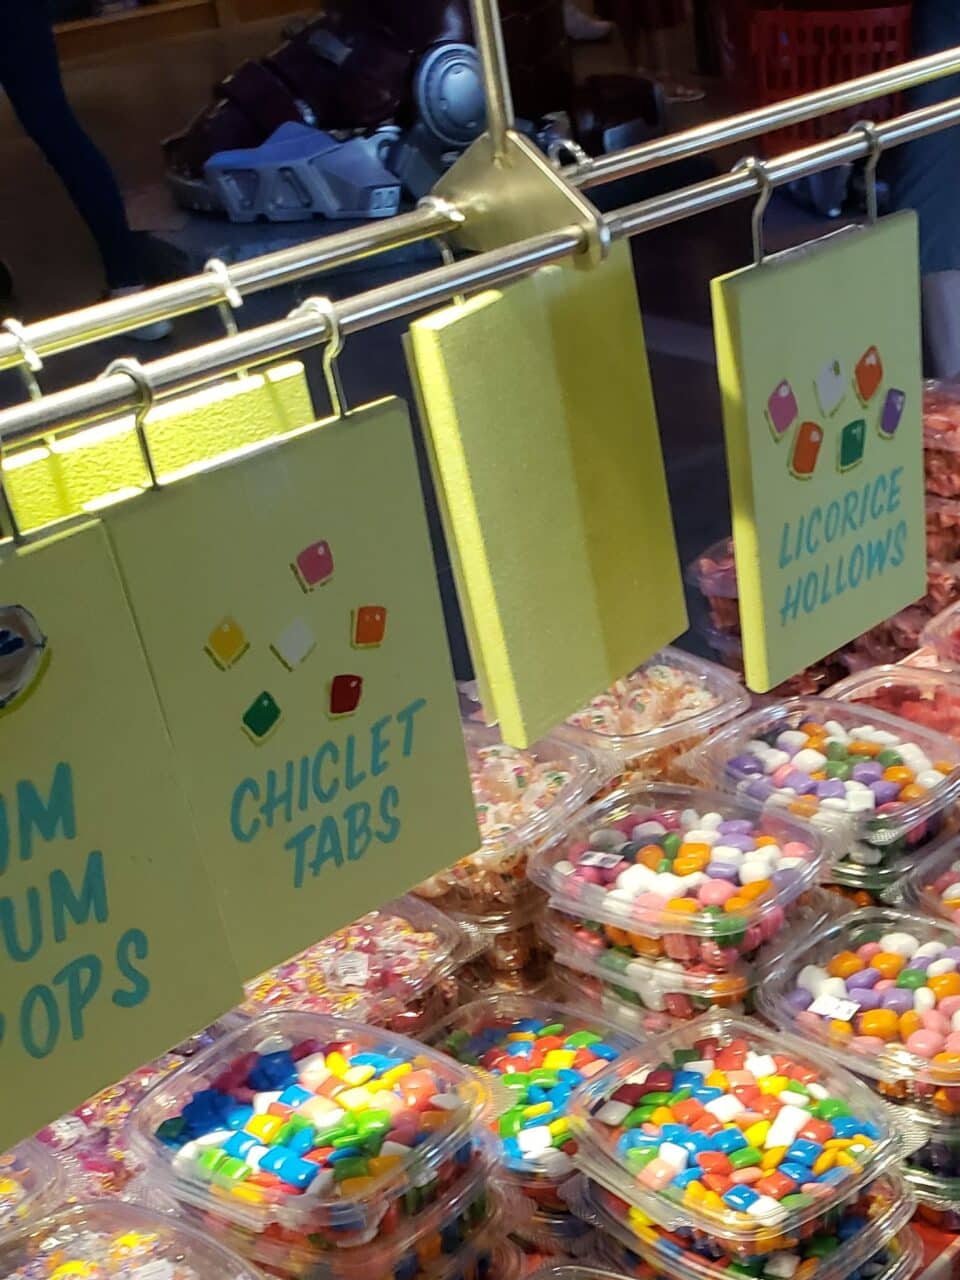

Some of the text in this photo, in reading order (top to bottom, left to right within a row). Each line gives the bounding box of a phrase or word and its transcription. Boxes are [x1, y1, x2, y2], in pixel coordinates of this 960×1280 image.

[779, 465, 904, 570] LICORICE
[779, 519, 907, 628] HOLLOWS
[229, 697, 427, 843] CHICLET
[283, 785, 401, 888] TABS
[0, 928, 150, 1059] OPS
